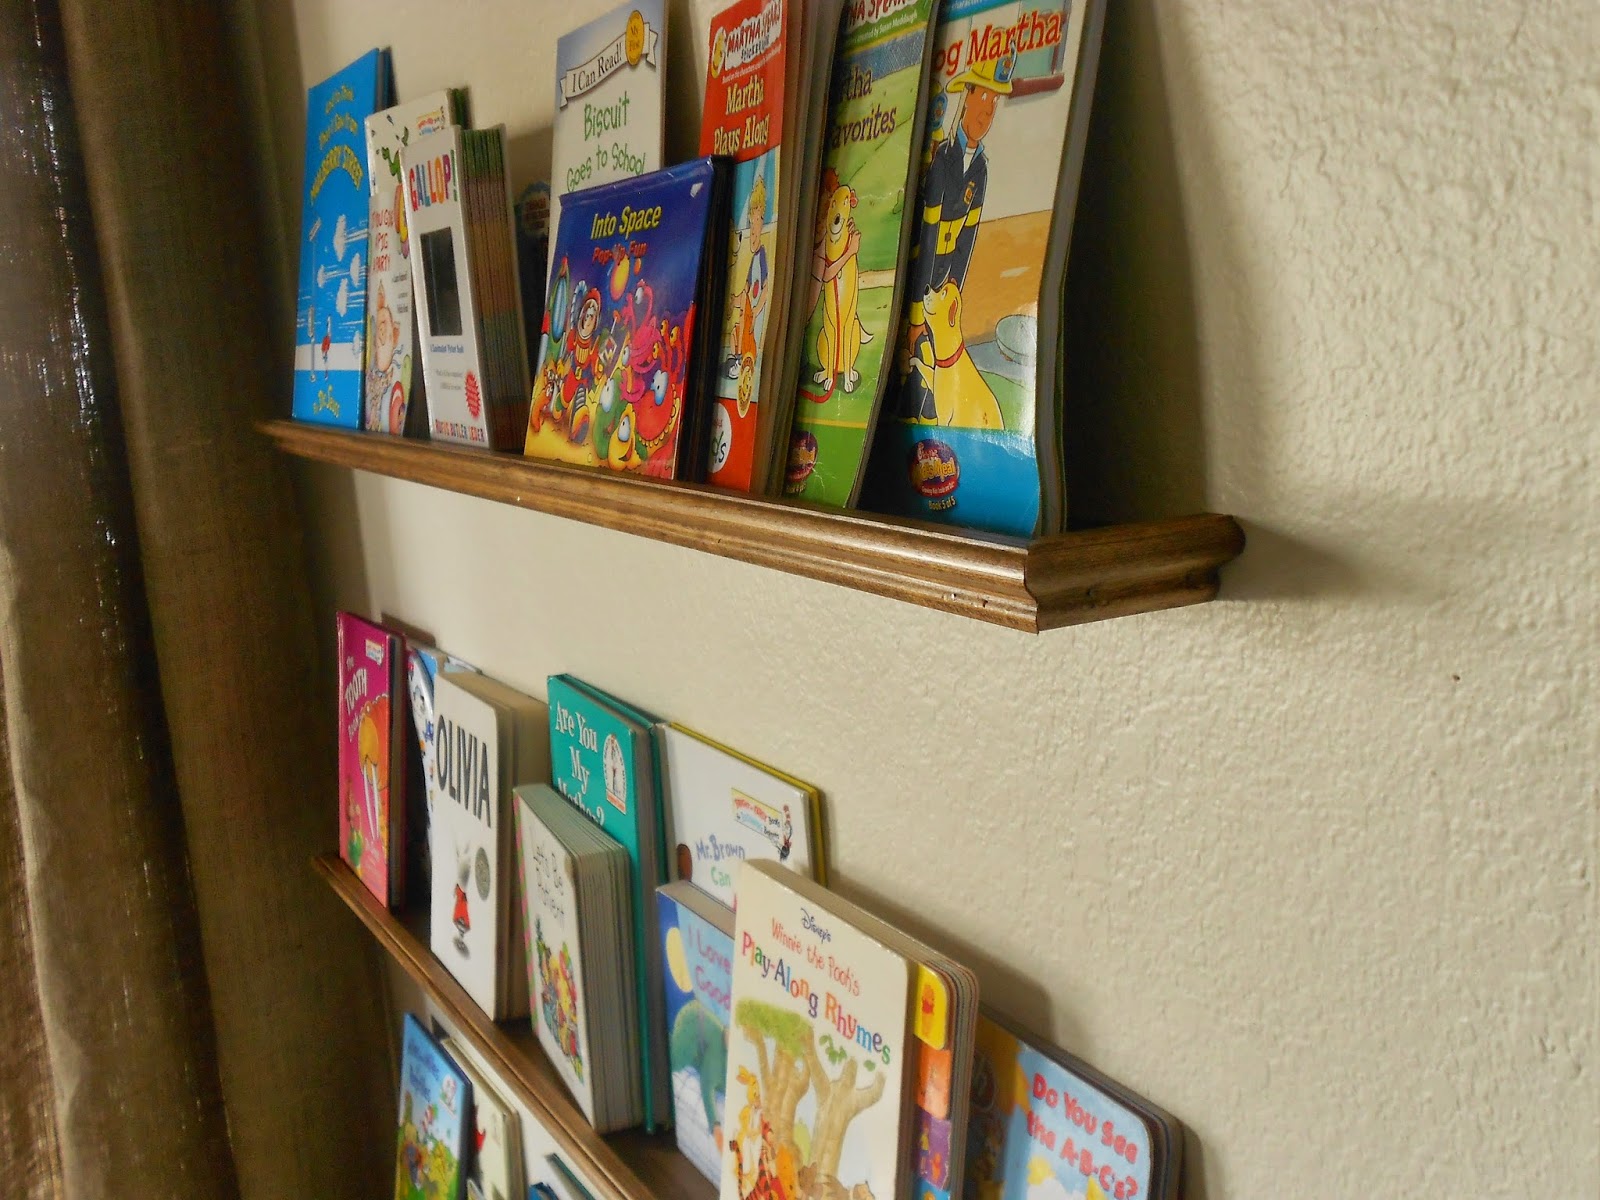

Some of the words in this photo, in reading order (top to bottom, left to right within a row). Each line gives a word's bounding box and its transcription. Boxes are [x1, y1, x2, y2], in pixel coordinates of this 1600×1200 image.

[966, 9, 1061, 66] Martha
[572, 73, 577, 93] I
[578, 70, 596, 91] Can
[597, 41, 622, 78] Read!
[584, 90, 630, 142] Biscuit
[725, 74, 765, 116] Martha
[714, 126, 741, 155] Plays
[742, 113, 770, 149] Along
[832, 103, 897, 149] avorites
[408, 149, 458, 213] GALLOP!
[567, 156, 592, 193] Goes
[595, 144, 608, 172] to
[611, 142, 646, 177] School
[590, 211, 617, 241] Into
[619, 205, 662, 241] Space
[628, 239, 649, 260] Fun
[711, 430, 727, 464] ds
[344, 668, 367, 716] TOOTH
[554, 699, 575, 737] Are
[575, 711, 598, 753] You
[436, 714, 492, 829] OLIVIA
[568, 746, 590, 795] My
[708, 833, 746, 861] Brown
[710, 866, 731, 888] Can
[696, 926, 732, 976] Love
[771, 917, 803, 955] Winnie
[806, 942, 825, 971] the
[828, 956, 862, 998] Pooh's
[742, 931, 819, 1019] Play-Along
[825, 991, 891, 1066] Rhymes
[1026, 1109, 1057, 1151] the
[1032, 1072, 1059, 1108] Do
[1062, 1090, 1099, 1135] You
[1101, 1119, 1139, 1165] See
